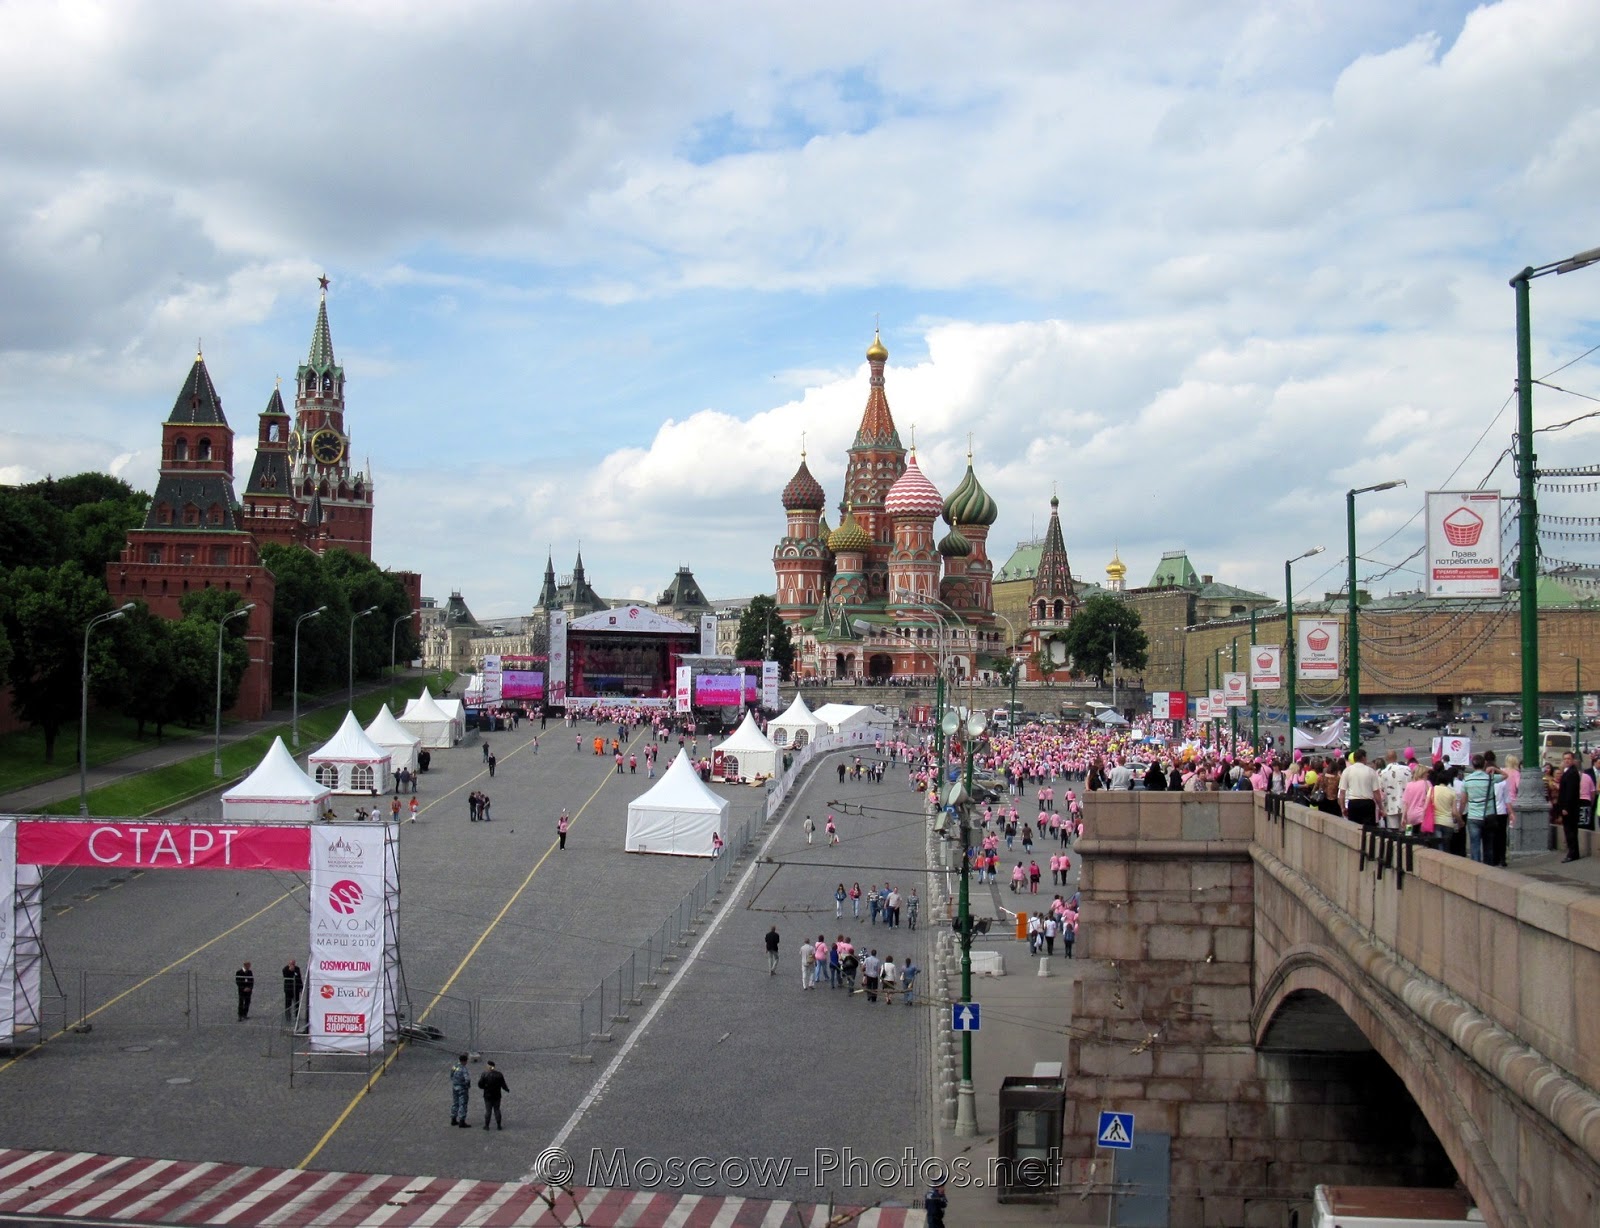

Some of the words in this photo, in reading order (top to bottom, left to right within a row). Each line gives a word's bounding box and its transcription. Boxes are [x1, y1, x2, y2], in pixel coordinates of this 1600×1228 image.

[1451, 550, 1477, 558] Права
[1435, 557, 1493, 566] потребителей
[88, 826, 239, 865] СТАРТ
[317, 918, 377, 931] AVON
[316, 938, 348, 947] МАРШ
[352, 939, 376, 947] 2010
[320, 960, 371, 971] COSMOPOLITAN
[337, 987, 370, 998] Eva.Ru
[326, 1014, 360, 1023] ЖЕНСКОЕ
[326, 1022, 363, 1032] ЗДОРОВЬЕ
